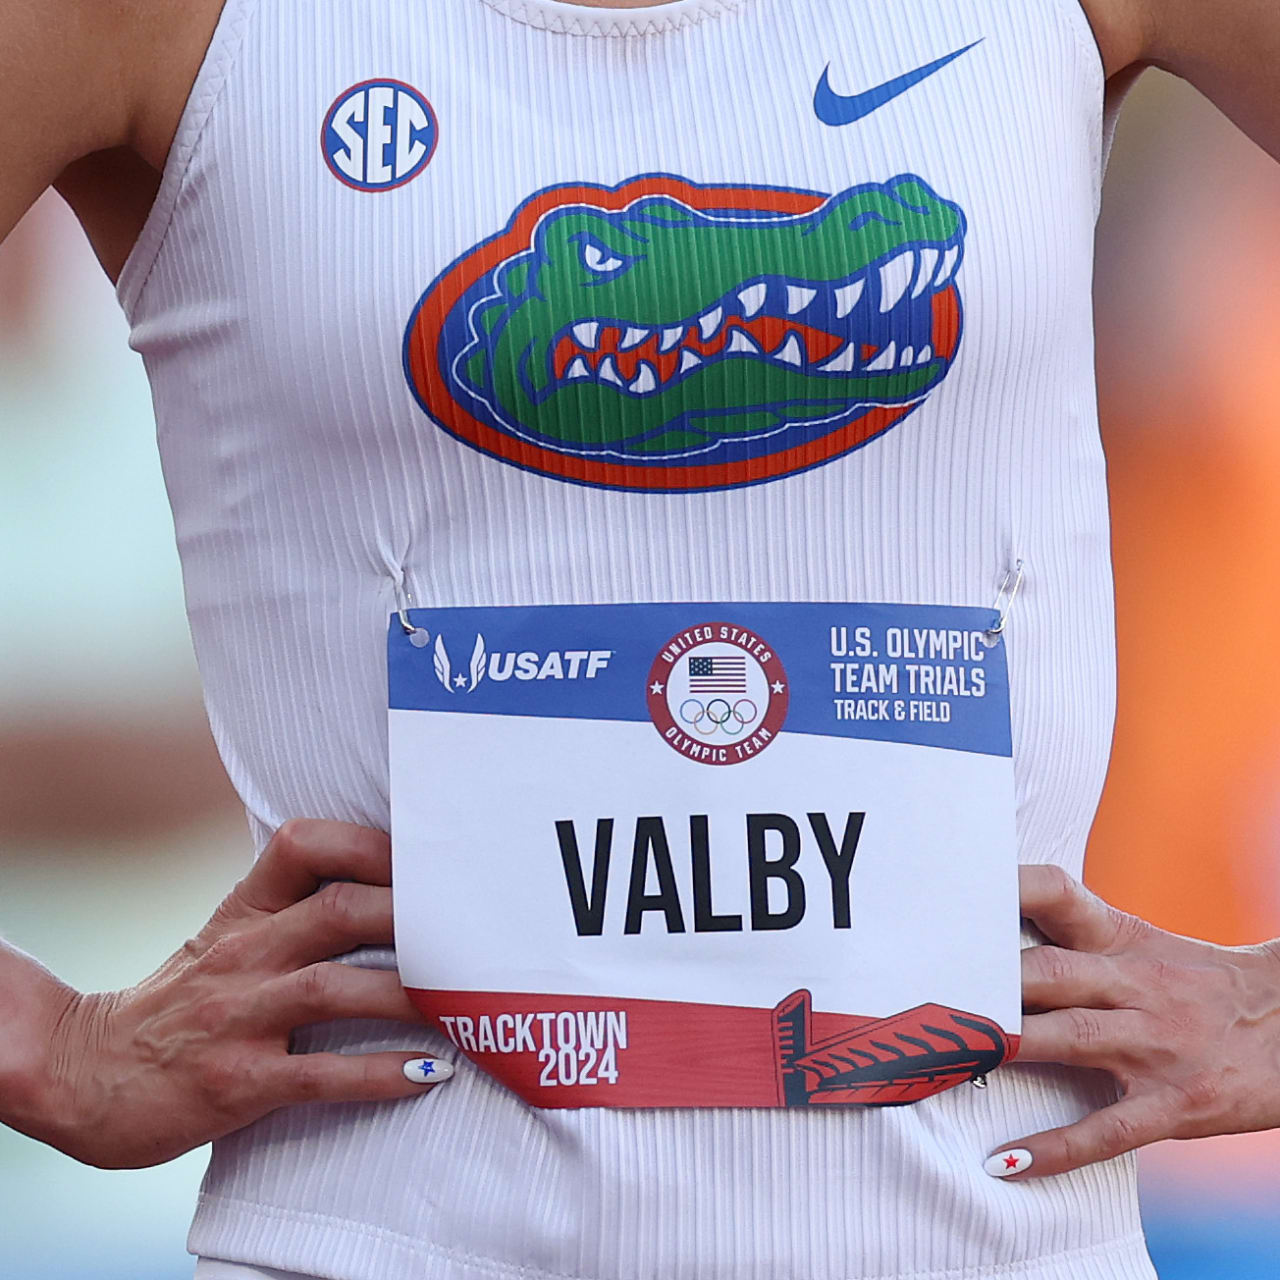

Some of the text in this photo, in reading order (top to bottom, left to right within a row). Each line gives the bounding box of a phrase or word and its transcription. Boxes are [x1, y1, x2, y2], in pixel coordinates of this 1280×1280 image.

[331, 87, 429, 183] SEC
[661, 626, 772, 663] UNITED STATES
[830, 626, 985, 662] U.S. OLYMPIC
[488, 650, 612, 682] USATF
[830, 663, 986, 697] TEAM TRIALS
[834, 699, 951, 723] TRACK & FIELD
[665, 726, 772, 762] OLYMPIC TEAM
[555, 812, 865, 936] VALBY
[439, 1011, 627, 1053] TRACKTOWN
[538, 1046, 619, 1086] 2024
